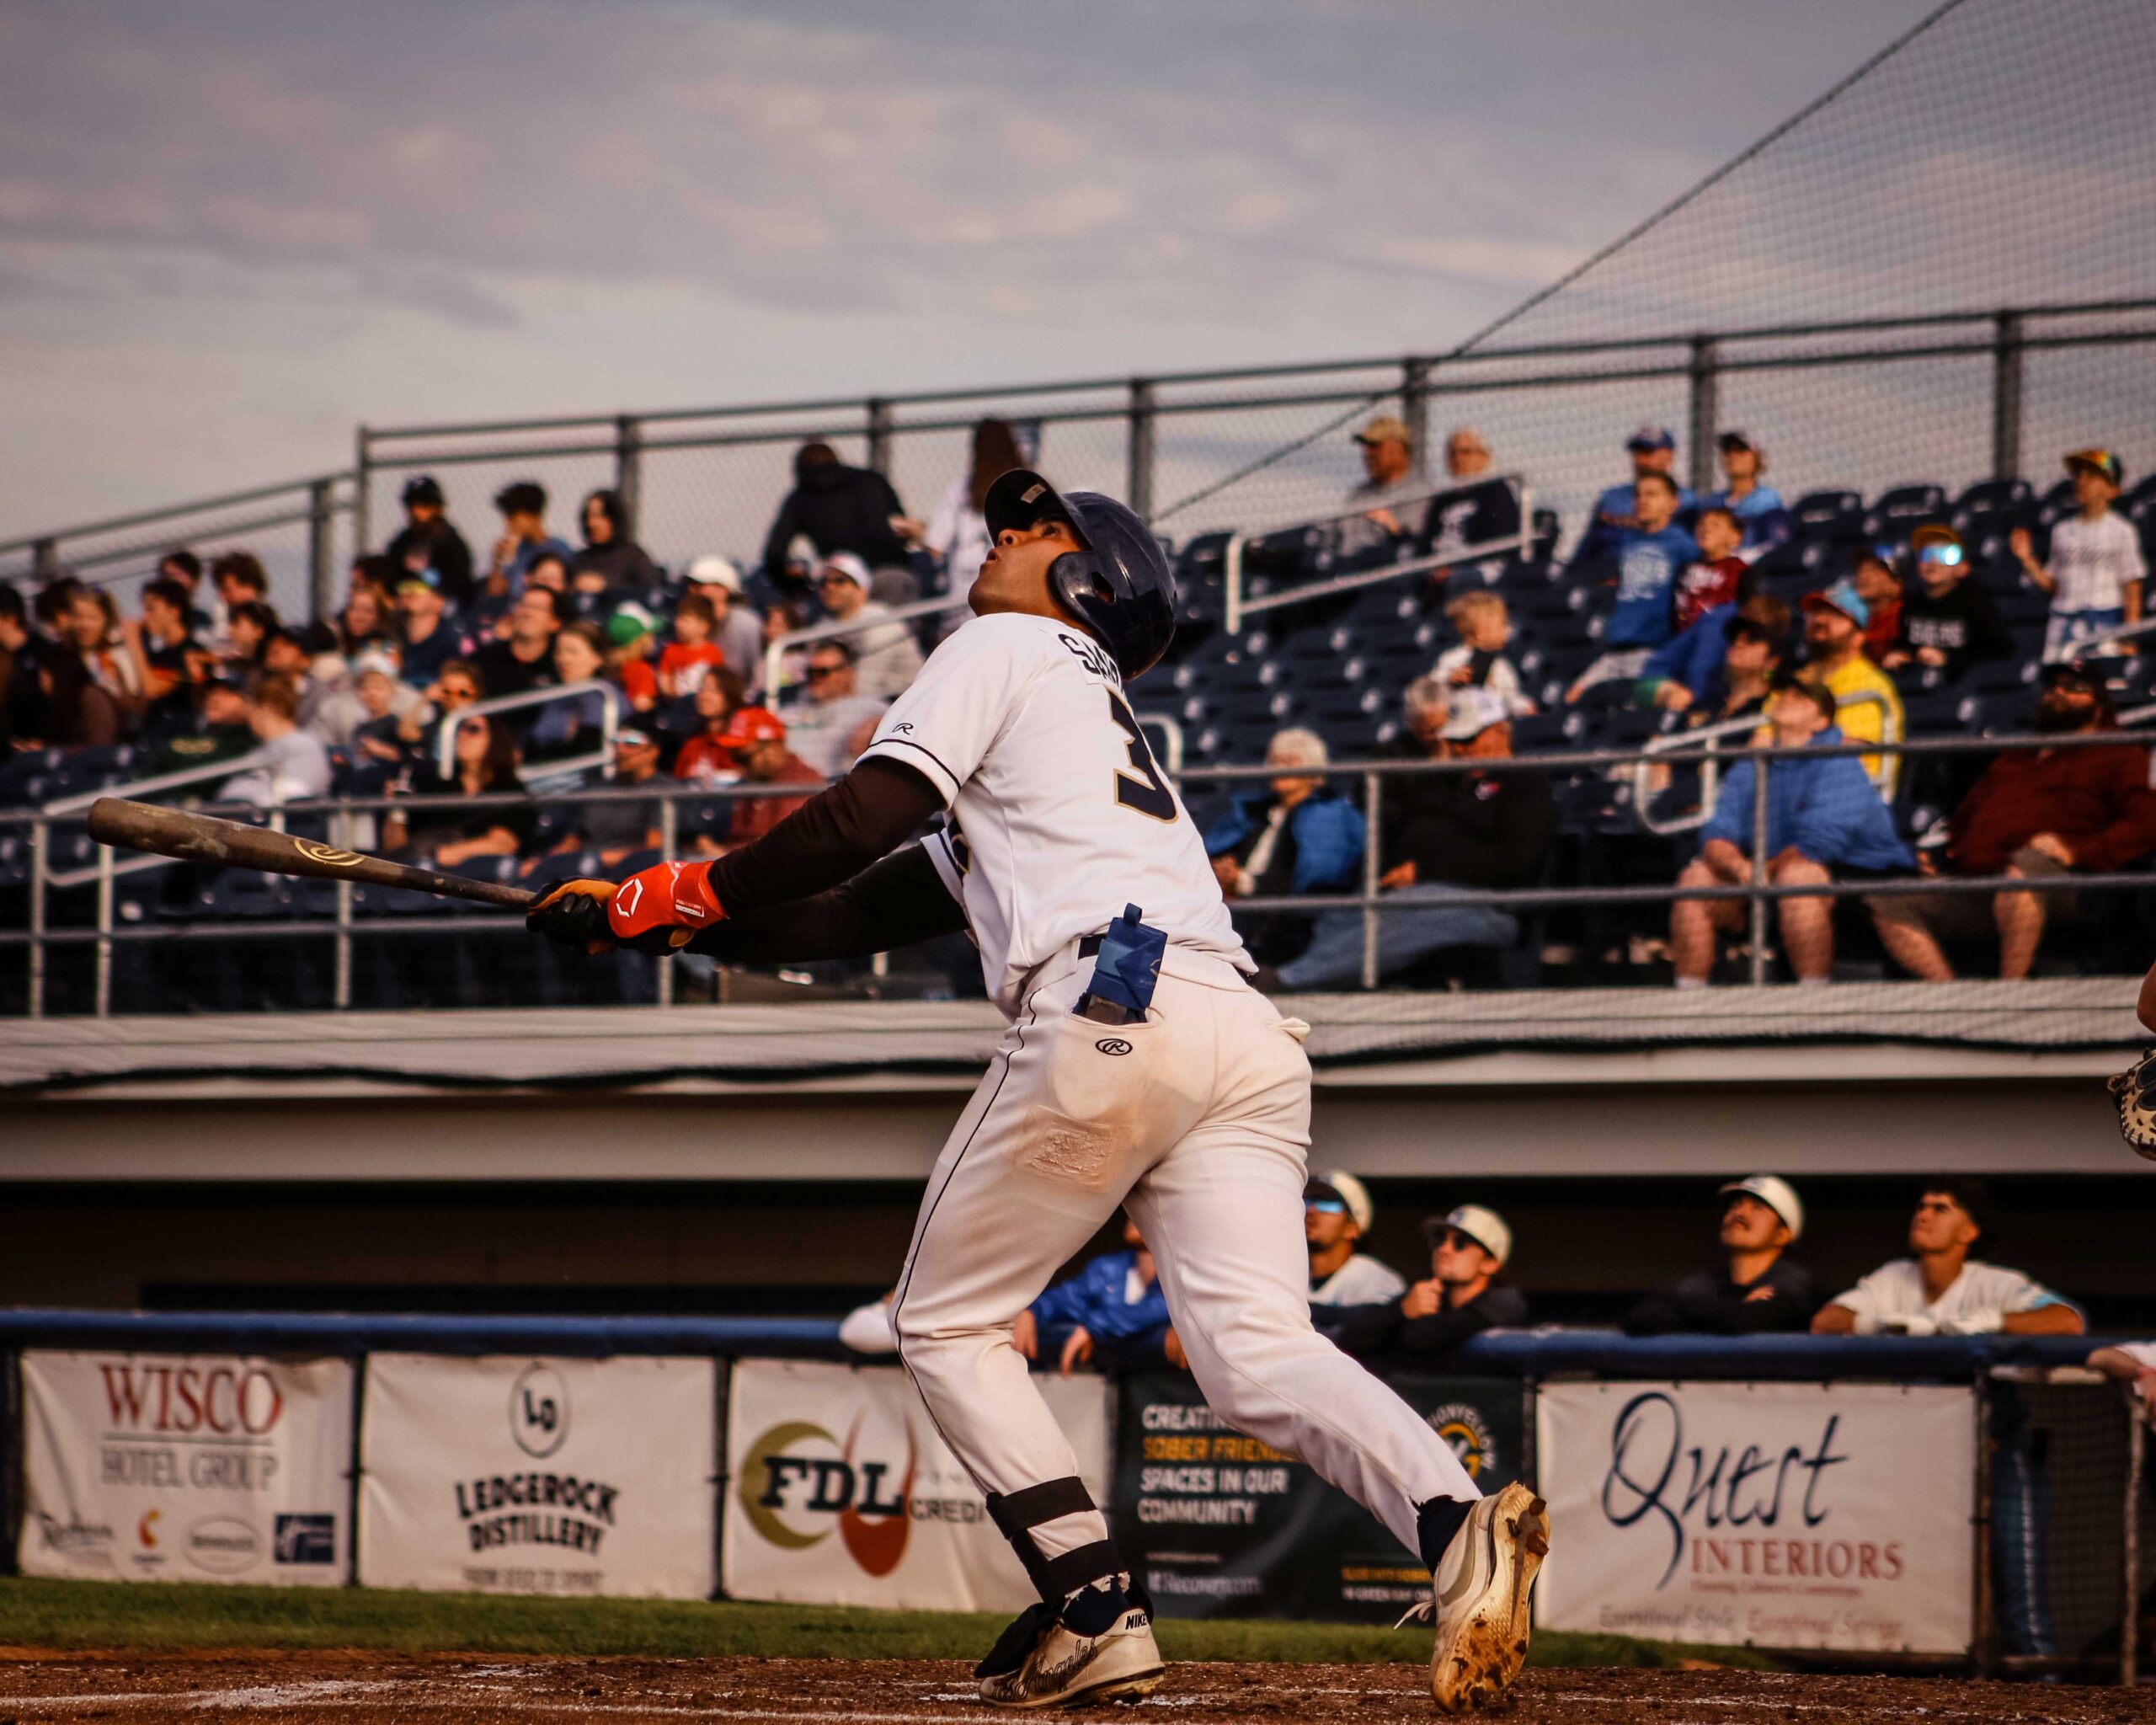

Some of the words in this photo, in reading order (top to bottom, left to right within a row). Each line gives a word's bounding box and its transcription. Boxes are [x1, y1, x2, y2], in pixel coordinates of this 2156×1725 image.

[1107, 686, 1179, 825] 3
[99, 1364, 283, 1434] WISCO
[1142, 1403, 1228, 1430] CREATI
[100, 1446, 184, 1489] HOTEL
[189, 1450, 280, 1493] GROUP
[1143, 1436, 1210, 1461] SOBER
[1213, 1437, 1283, 1462] FRIEND
[455, 1473, 621, 1528] LEDGEROCK
[759, 1455, 905, 1517] FDL
[1140, 1467, 1216, 1493] SPACES
[1219, 1467, 1242, 1493] IN
[1244, 1467, 1289, 1494] OUR
[1602, 1391, 1850, 1591] Quest
[910, 1498, 985, 1524] CREDI
[1138, 1498, 1257, 1525] COMMUNITY
[468, 1514, 605, 1557] DISTILLERY
[1689, 1538, 1905, 1581] INTERIORS
[1125, 1613, 1147, 1631] NIKE
